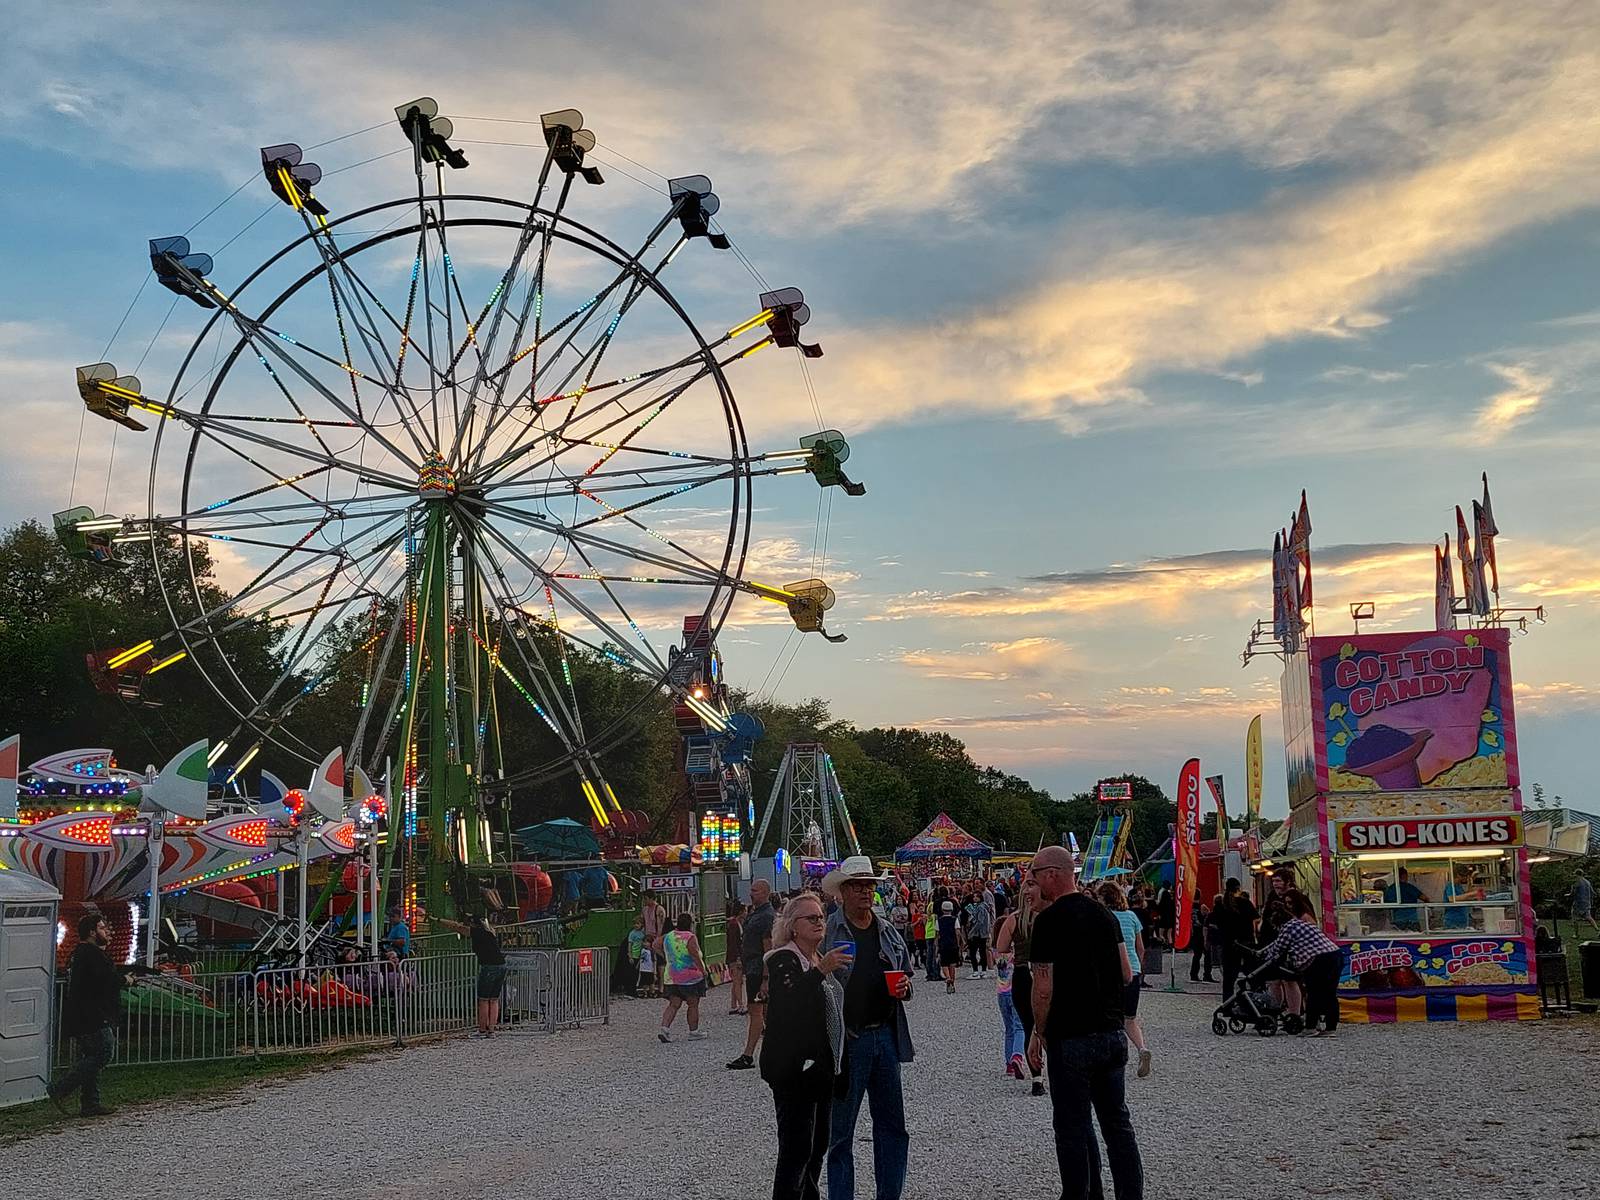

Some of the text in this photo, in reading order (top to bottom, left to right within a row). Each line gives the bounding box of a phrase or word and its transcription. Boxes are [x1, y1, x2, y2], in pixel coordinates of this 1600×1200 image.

[1335, 647, 1485, 688] COTTON
[1350, 671, 1473, 716] CANDY
[1349, 820, 1509, 847] SNO-KONES
[652, 877, 689, 888] EXIT
[583, 954, 588, 965] 4
[1452, 942, 1498, 958] POP
[1351, 954, 1412, 976] APPLES
[1446, 953, 1509, 975] CORN
